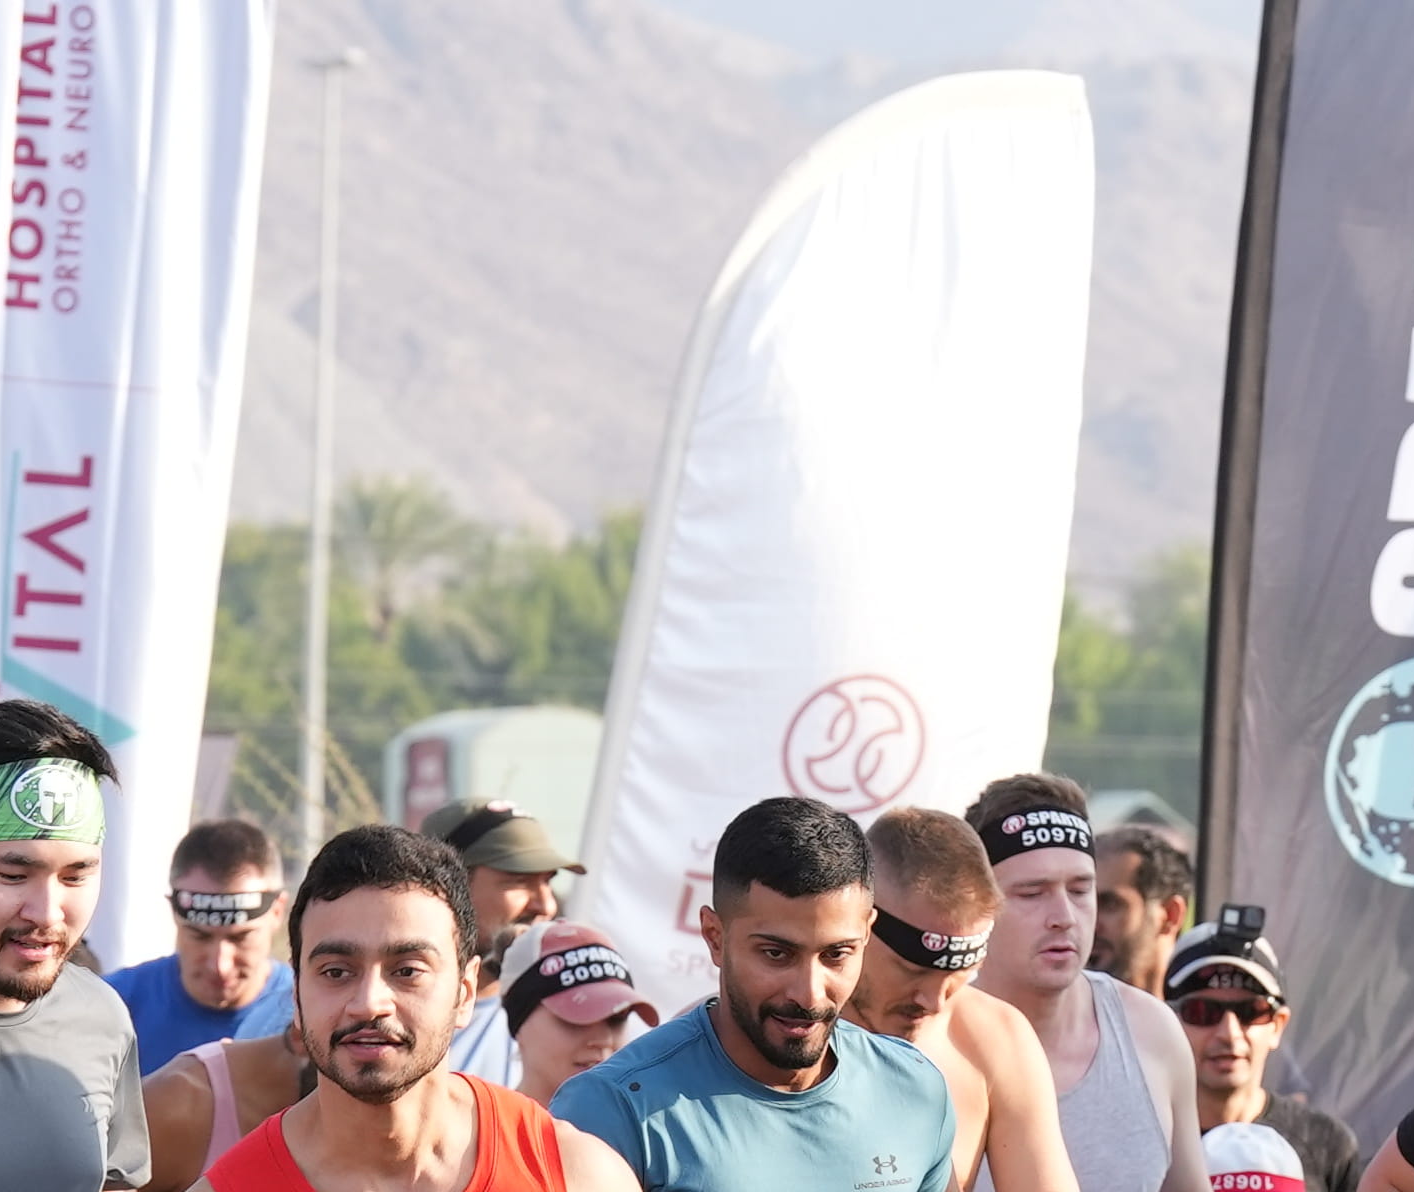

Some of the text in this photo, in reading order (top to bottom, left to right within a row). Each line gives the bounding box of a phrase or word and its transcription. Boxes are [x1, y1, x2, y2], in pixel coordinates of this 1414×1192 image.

[4, 3, 58, 310] HOSPITAL
[51, 3, 97, 314] ORTHO & NEURO
[1021, 826, 1089, 849] 50975
[1212, 1174, 1275, 1190] 10687
